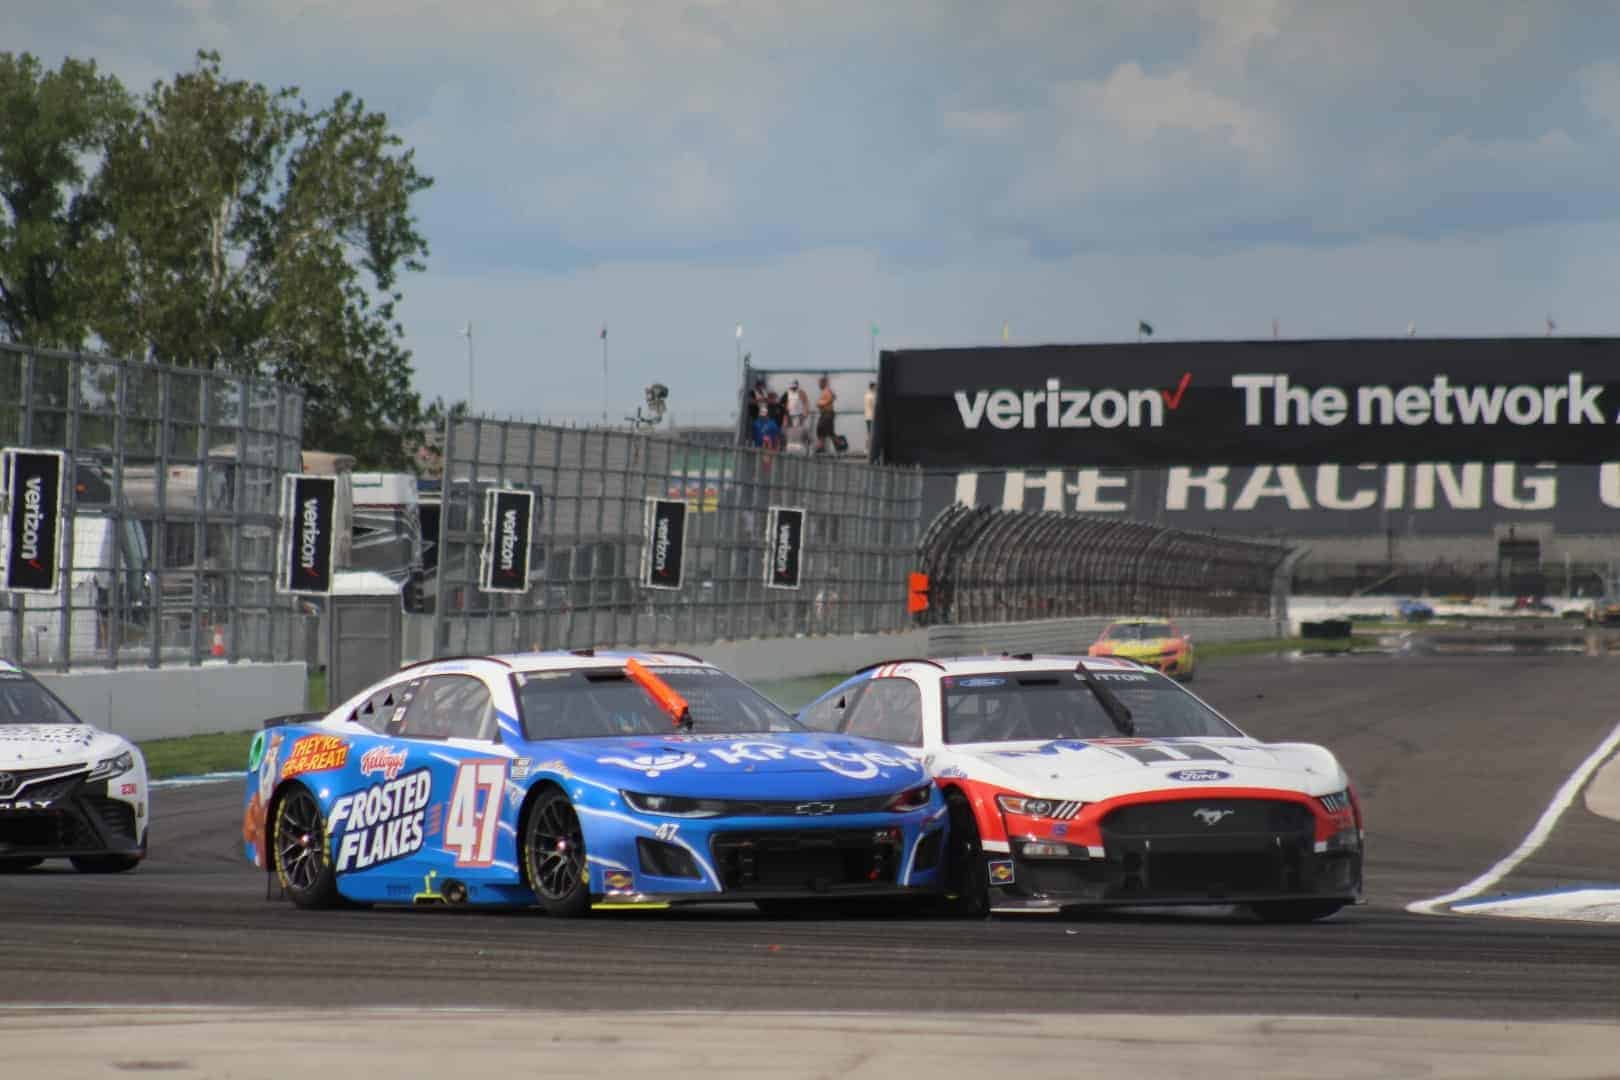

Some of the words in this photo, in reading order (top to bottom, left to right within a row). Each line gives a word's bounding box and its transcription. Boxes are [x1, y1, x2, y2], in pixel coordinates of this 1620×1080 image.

[954, 378, 1164, 429] verizon
[1231, 374, 1347, 426] The
[1357, 372, 1605, 426] network
[1165, 463, 1557, 510] RACING
[21, 478, 44, 559] verizon
[301, 498, 320, 568] verizon
[501, 510, 518, 570] verizon
[656, 518, 671, 570] verizon
[329, 770, 431, 834] FROSTED
[445, 760, 506, 866] 47
[655, 823, 680, 840] 47
[336, 811, 425, 873] FLAKES
